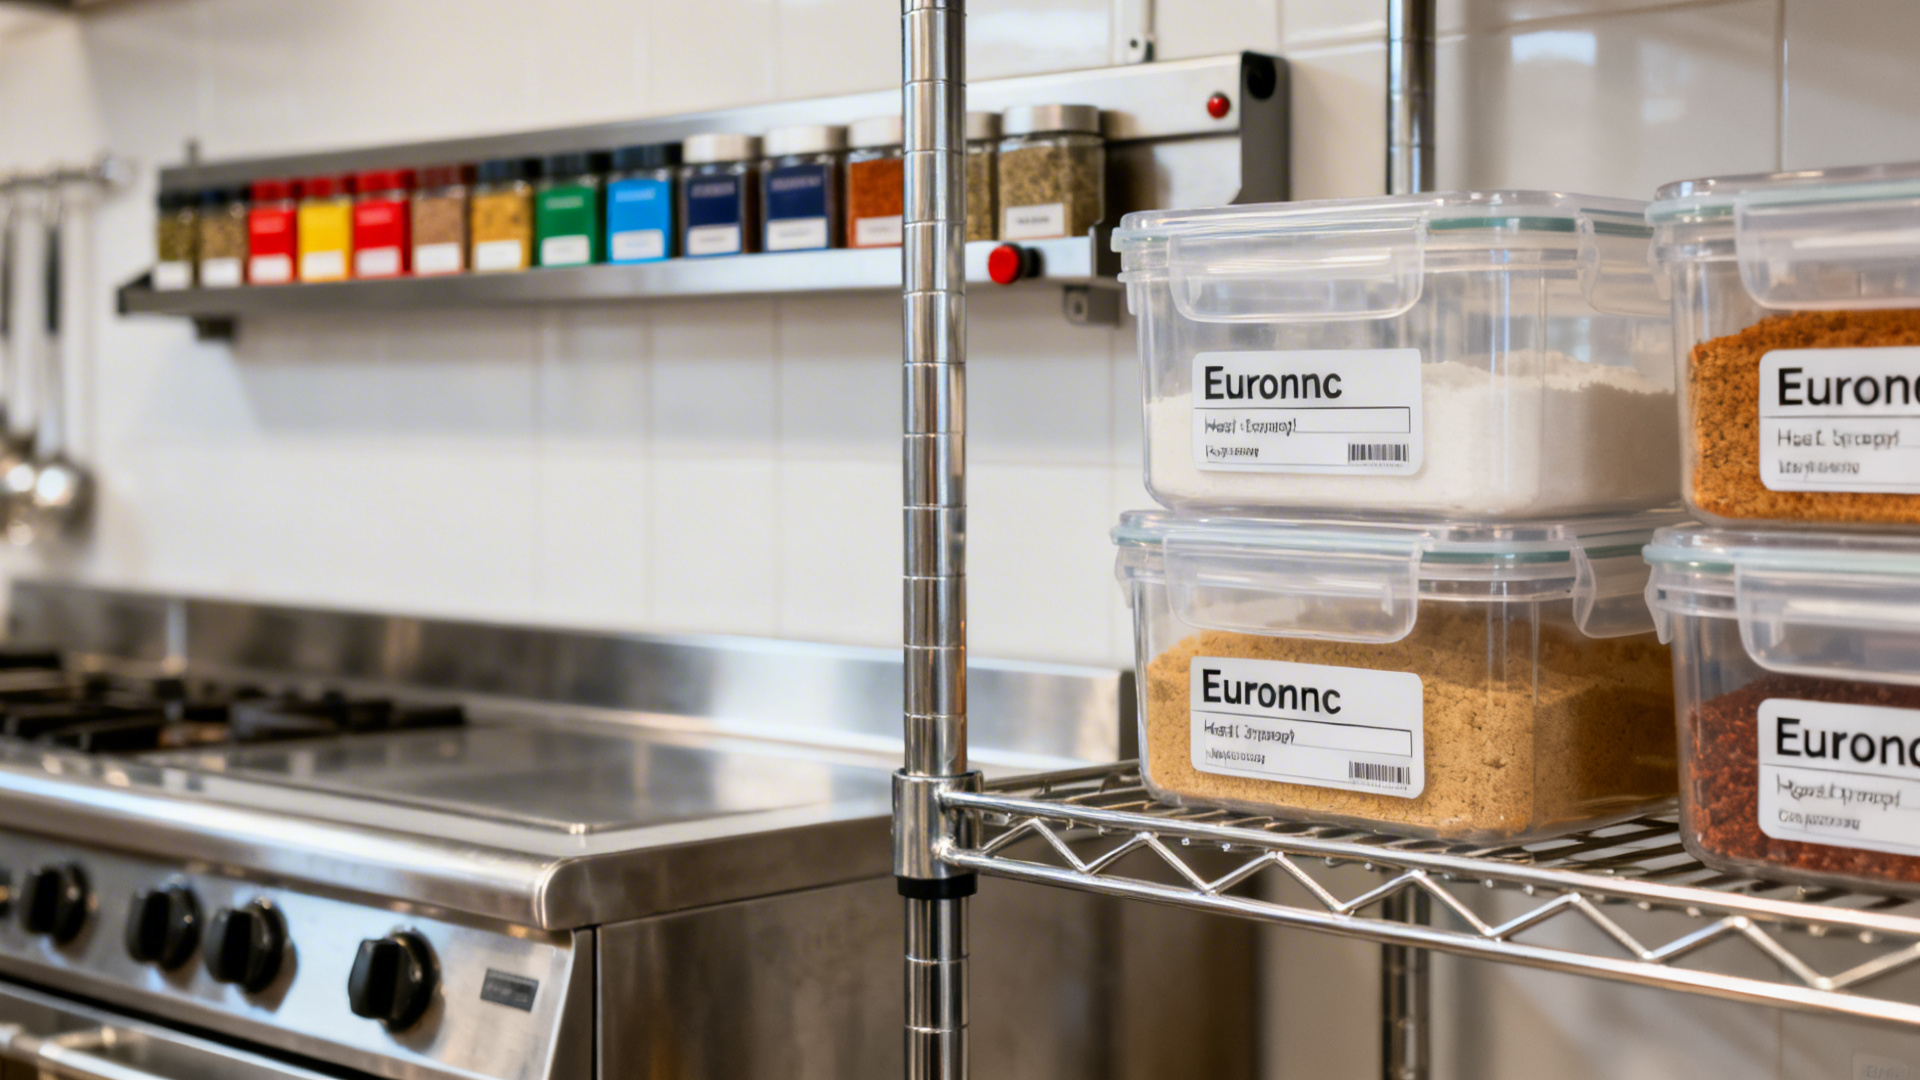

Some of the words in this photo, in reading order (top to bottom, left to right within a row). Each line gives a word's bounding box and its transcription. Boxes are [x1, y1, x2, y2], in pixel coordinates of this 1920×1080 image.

[1205, 366, 1342, 400] Euronnc
[1778, 367, 1920, 406] Euron
[1203, 669, 1341, 715] Euronnc
